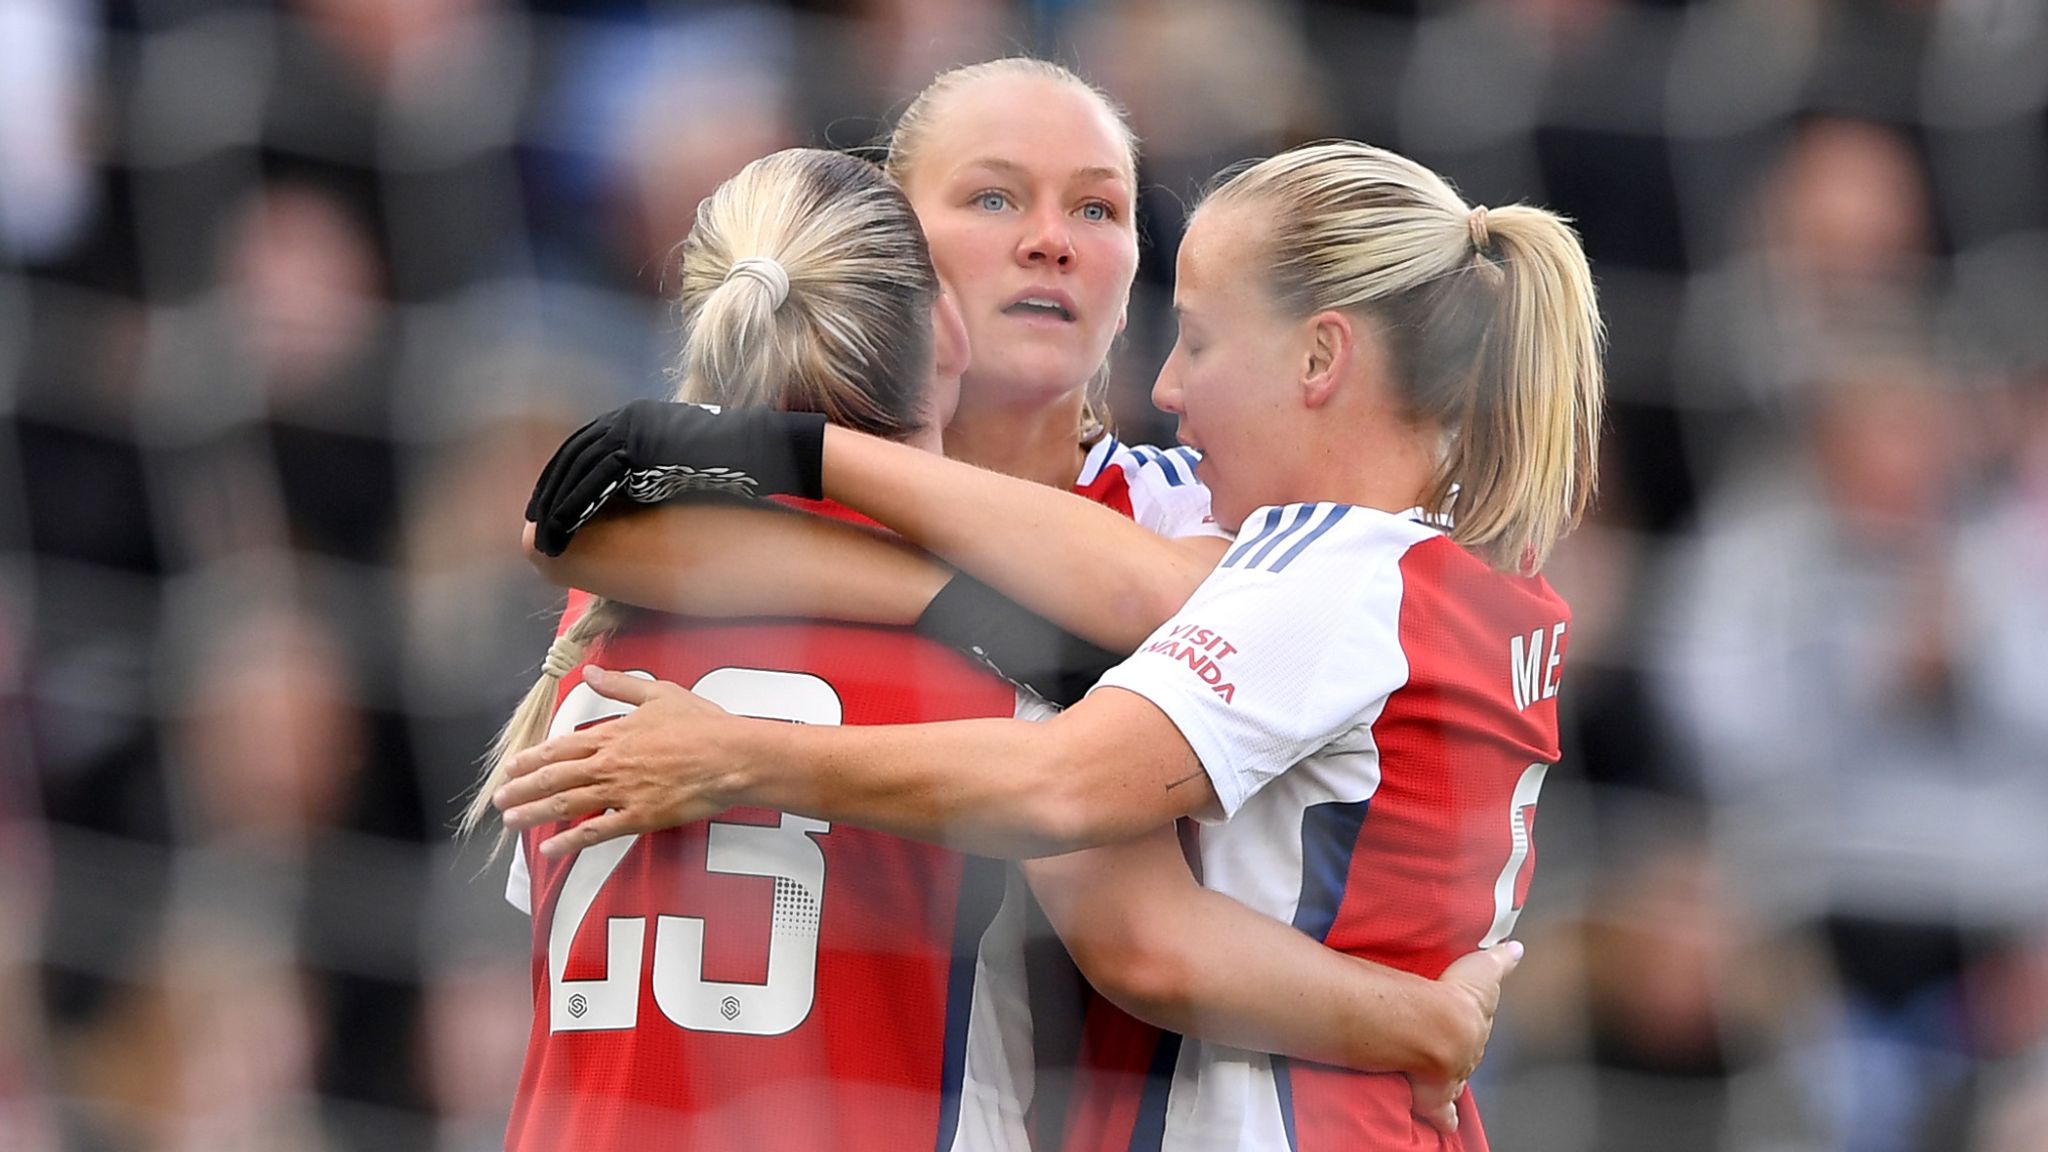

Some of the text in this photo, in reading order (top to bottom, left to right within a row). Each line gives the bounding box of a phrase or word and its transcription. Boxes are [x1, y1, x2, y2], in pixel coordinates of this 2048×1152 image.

[1169, 624, 1238, 660] VISIT
[1510, 621, 1566, 712] ME
[547, 666, 843, 1038] 23
